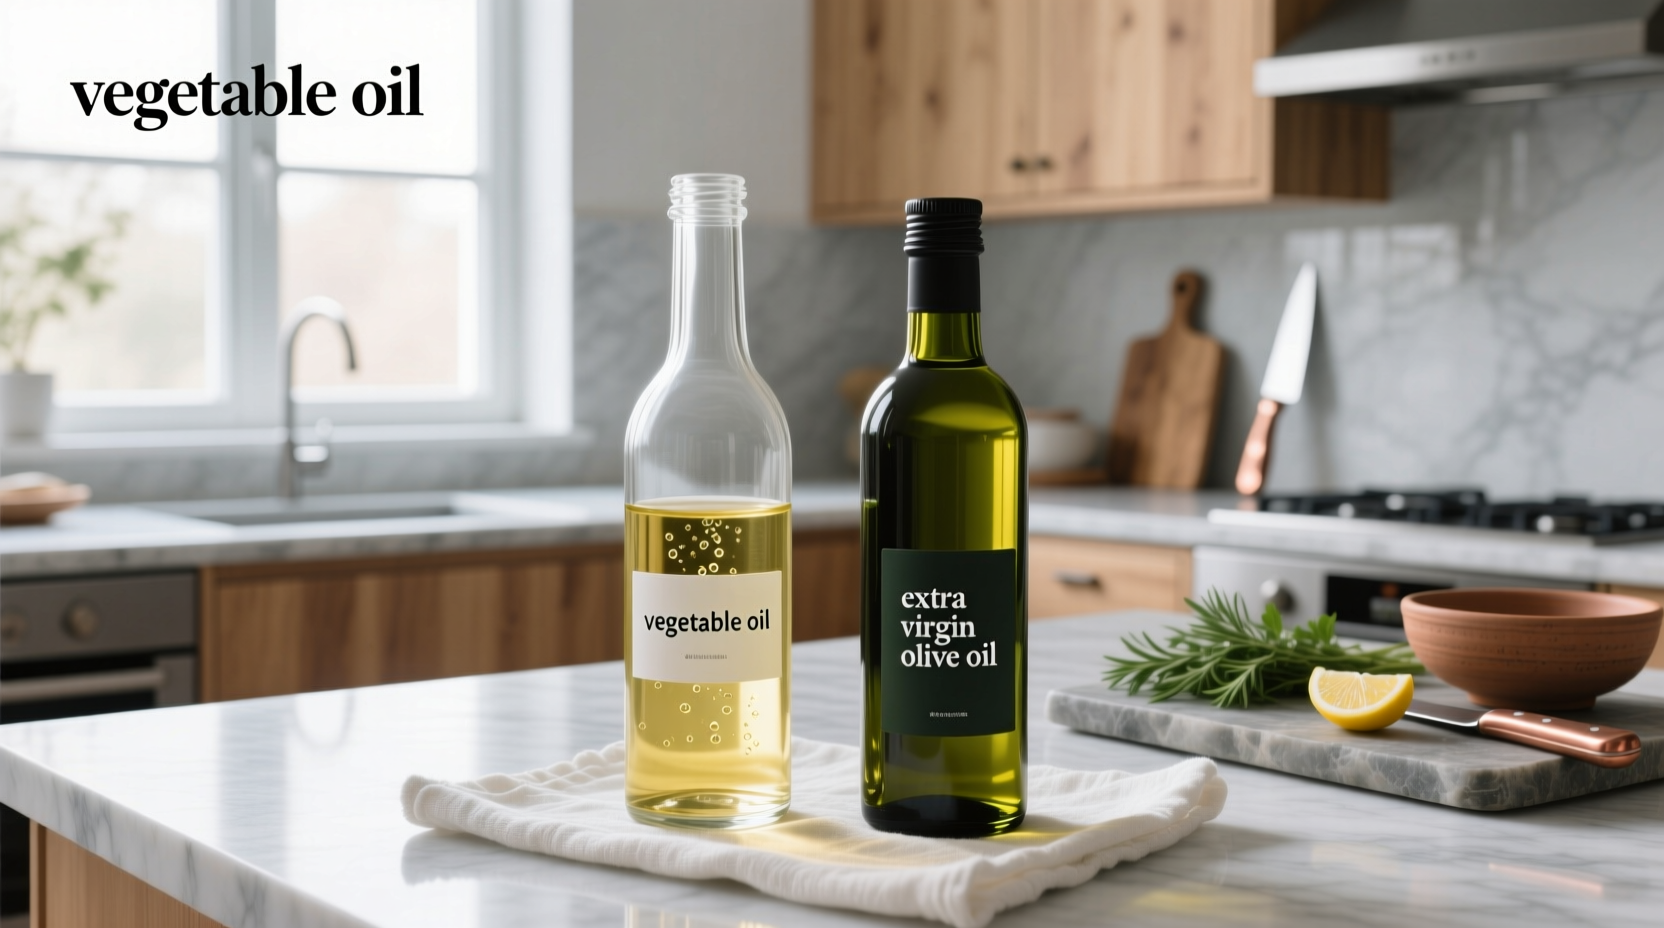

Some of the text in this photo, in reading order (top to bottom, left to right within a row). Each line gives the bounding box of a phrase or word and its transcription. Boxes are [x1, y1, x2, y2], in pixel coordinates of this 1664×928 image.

[901, 588, 967, 609] extra
[644, 608, 770, 638] vegetable oil
[900, 613, 976, 646] virgin
[900, 640, 998, 667] olive oil
